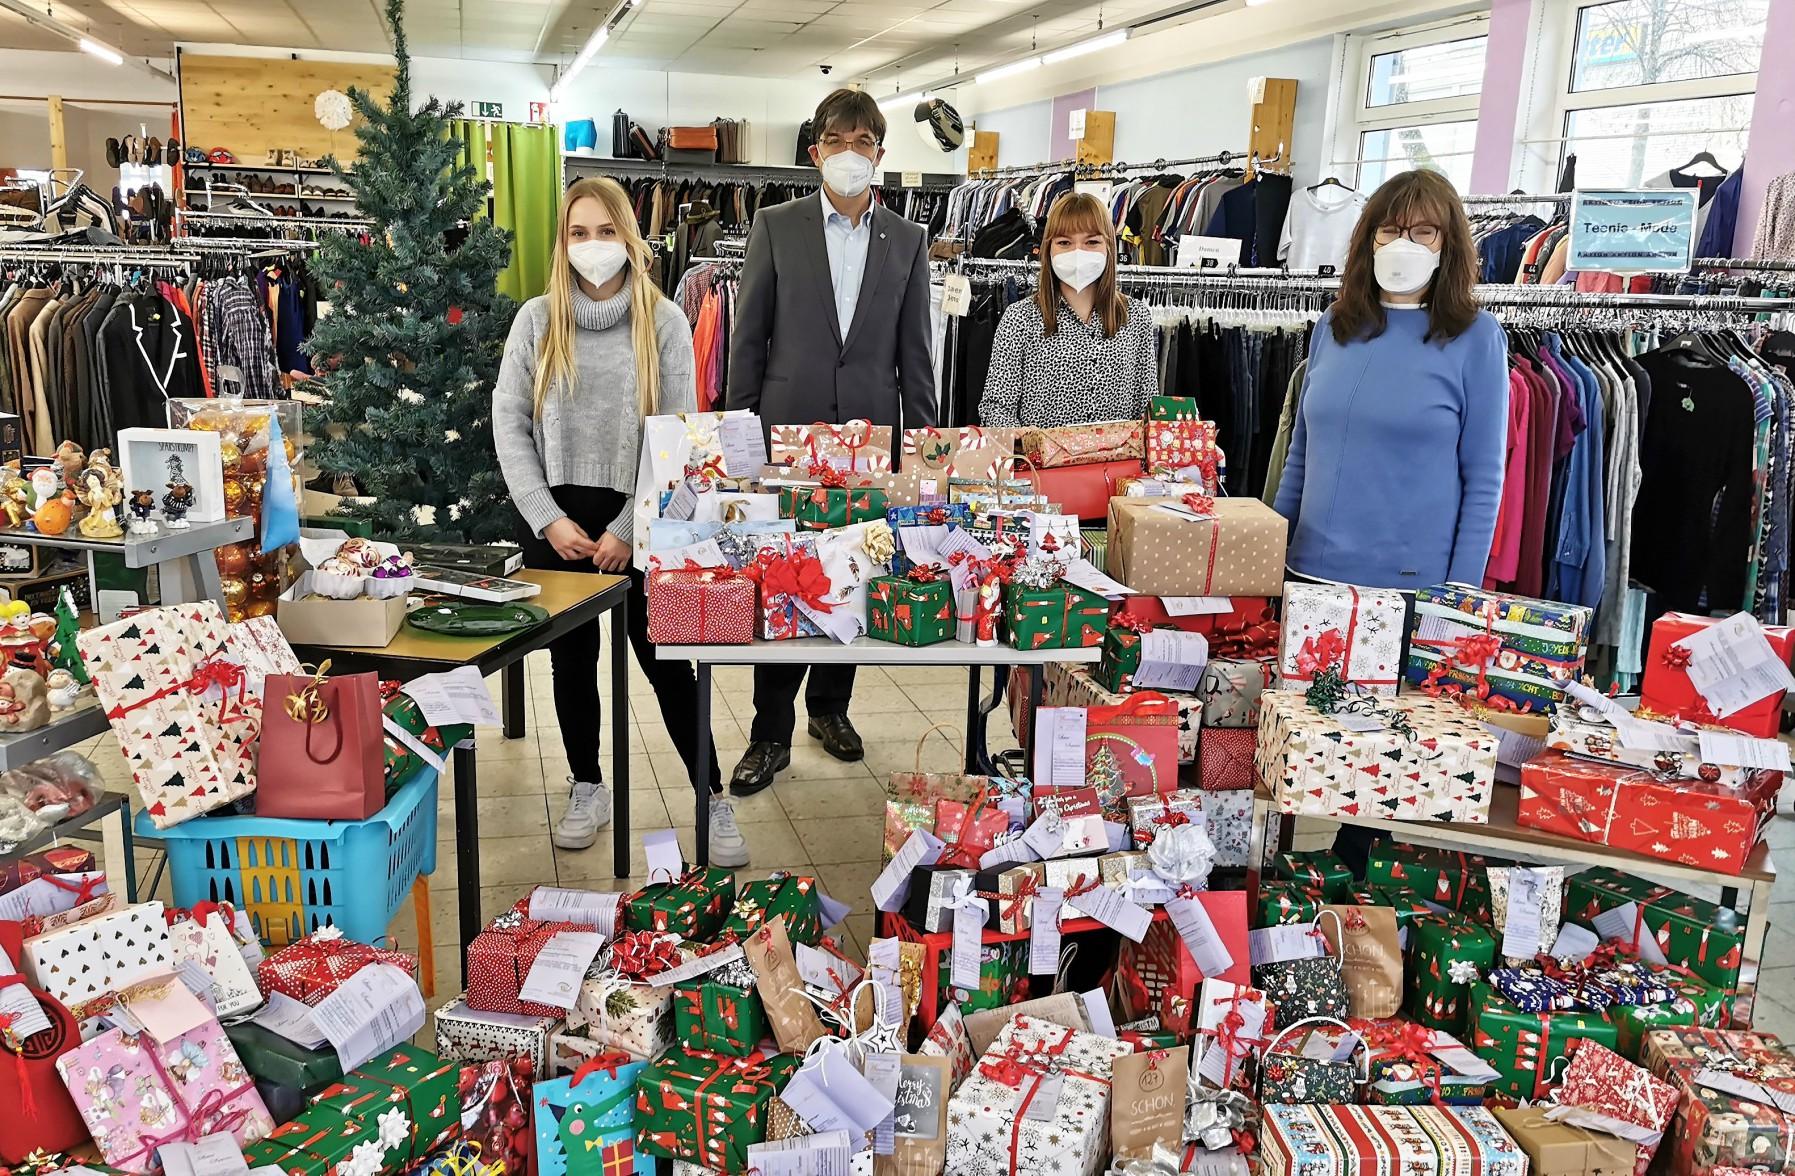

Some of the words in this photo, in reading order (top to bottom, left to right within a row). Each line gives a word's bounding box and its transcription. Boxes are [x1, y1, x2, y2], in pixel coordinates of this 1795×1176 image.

[1120, 254, 1127, 262] 36
[1141, 1072, 1158, 1086] 127
[897, 1086, 932, 1109] istmas
